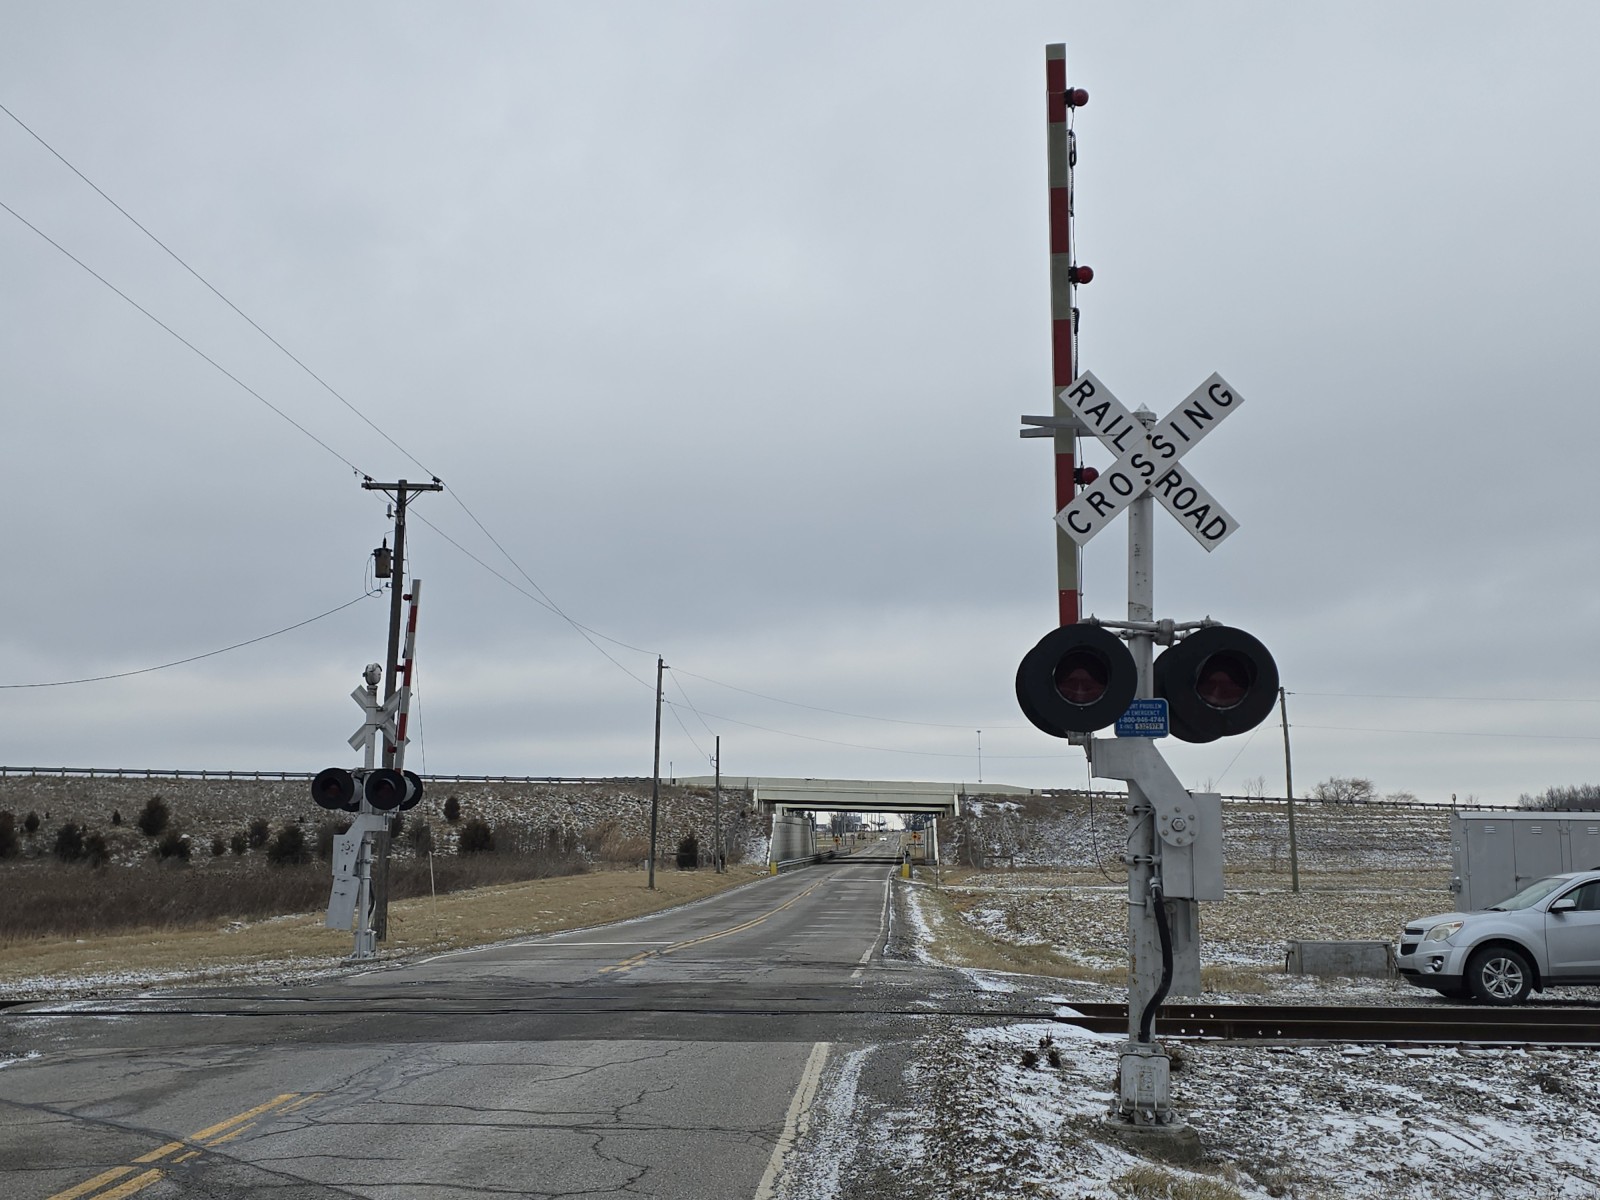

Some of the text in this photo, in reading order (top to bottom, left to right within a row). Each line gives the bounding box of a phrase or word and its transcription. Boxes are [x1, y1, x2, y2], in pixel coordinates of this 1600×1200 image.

[1067, 383, 1233, 534] CROSSING
[1068, 379, 1227, 541] RAIL ROAD
